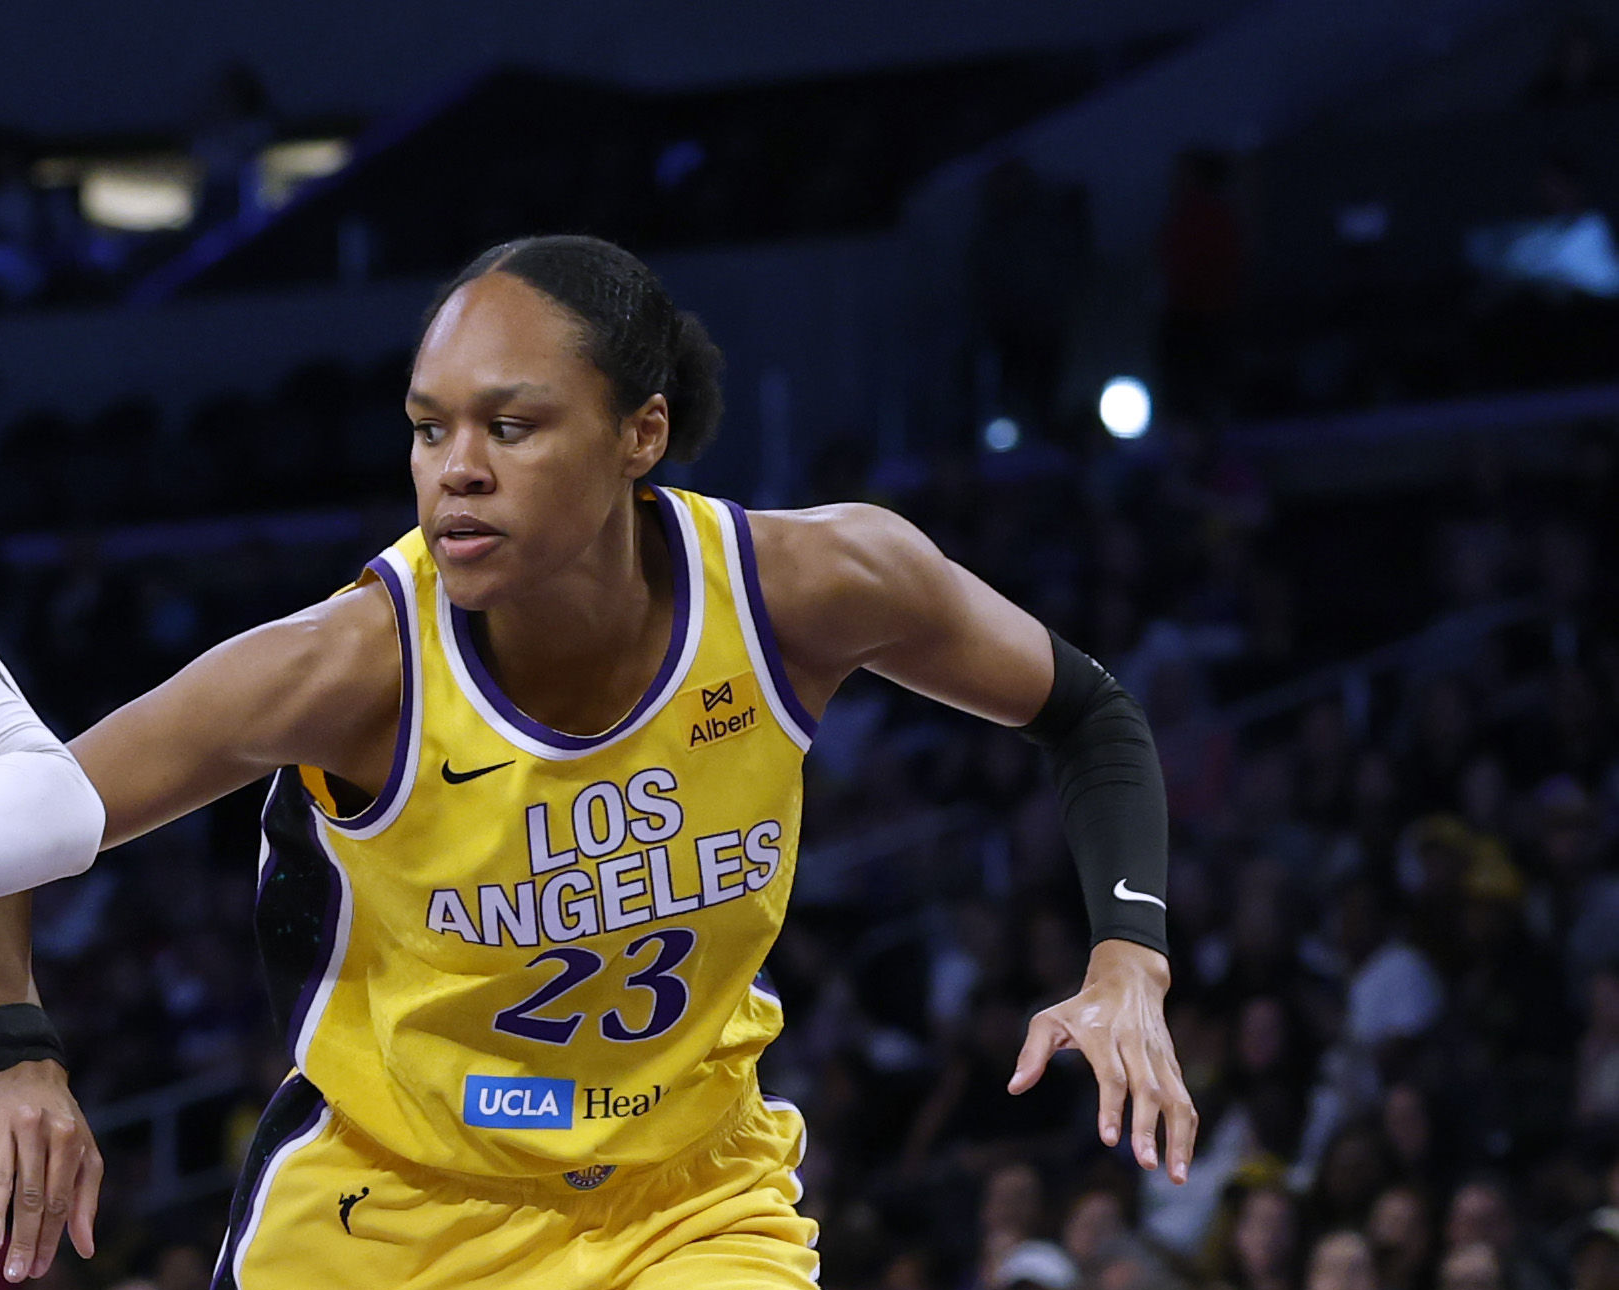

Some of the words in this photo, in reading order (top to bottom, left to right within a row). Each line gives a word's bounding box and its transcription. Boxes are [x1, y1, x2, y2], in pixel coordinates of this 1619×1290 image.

[689, 705, 757, 747] Albert
[526, 767, 684, 877] LOS
[425, 819, 782, 947] ANGELES
[491, 927, 697, 1045] 23
[478, 1088, 560, 1117] UCLA
[582, 1084, 671, 1120] Heal
